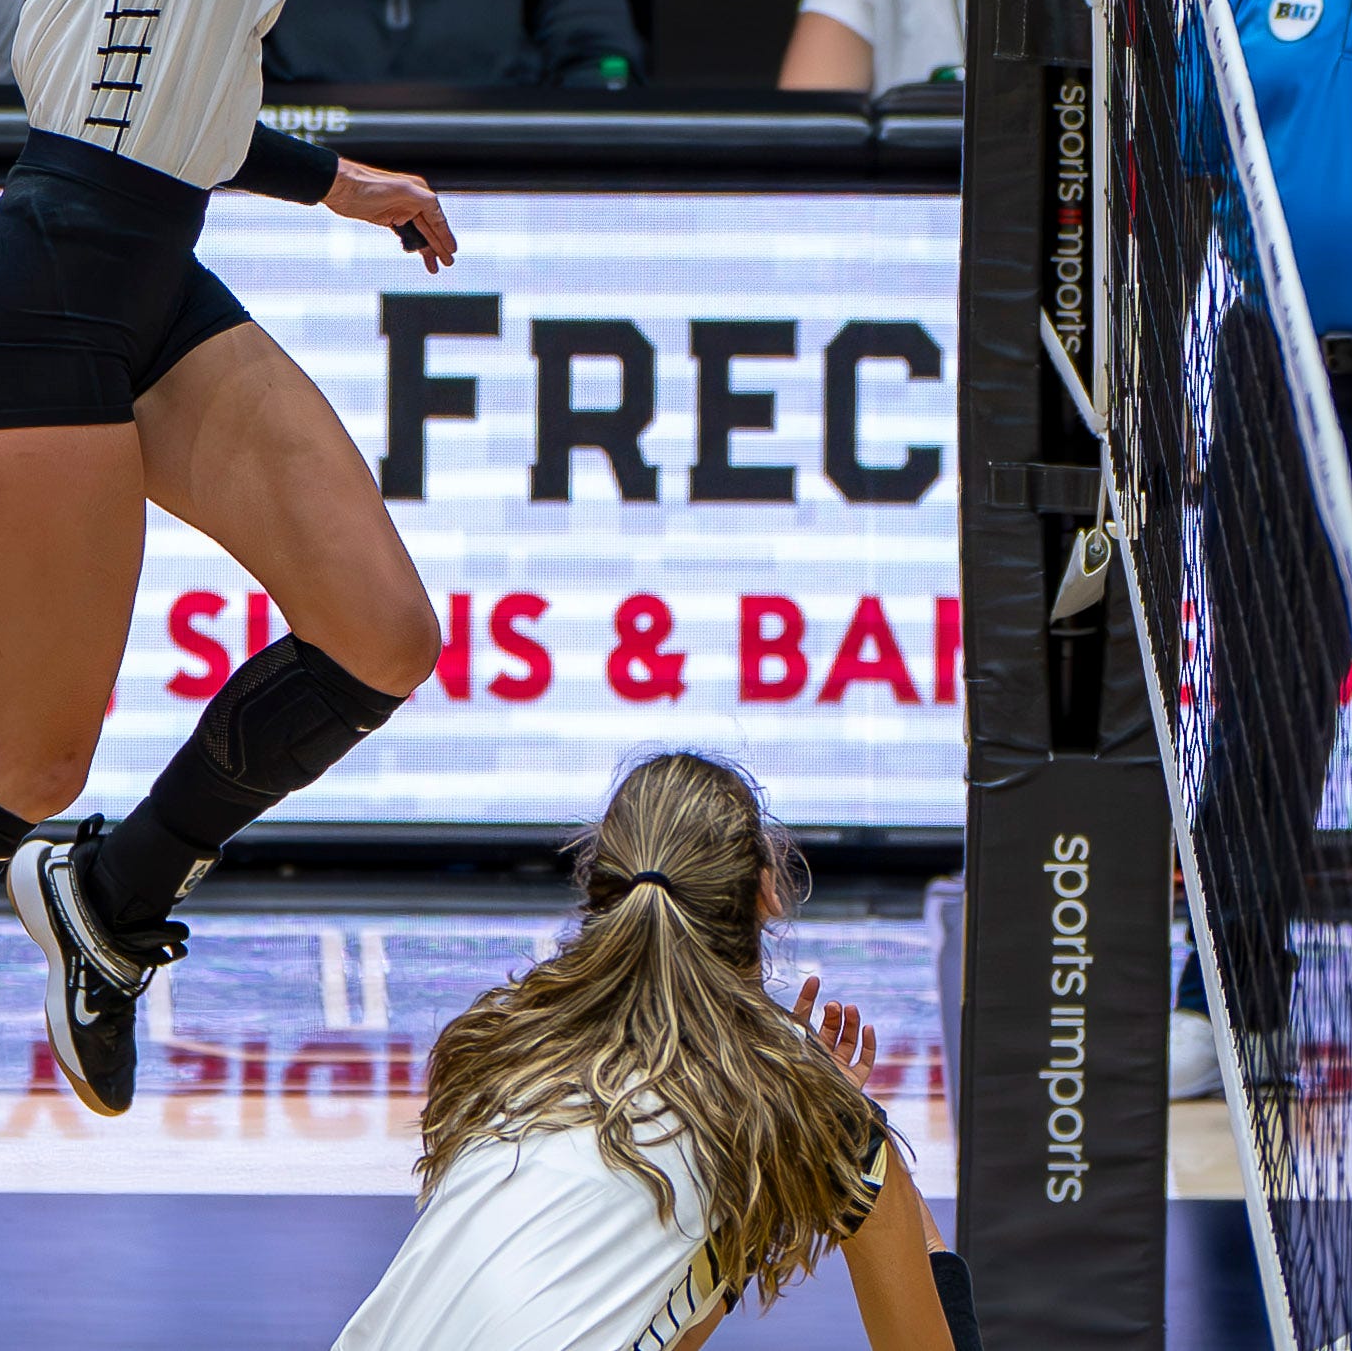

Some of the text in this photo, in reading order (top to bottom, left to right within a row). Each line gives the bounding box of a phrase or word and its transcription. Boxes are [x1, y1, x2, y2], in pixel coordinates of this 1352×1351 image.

[1052, 84, 1088, 201] sports
[380, 292, 944, 505] FREC
[606, 592, 686, 704] &
[738, 594, 960, 706] BA
[1039, 834, 1094, 1204] sports imports
